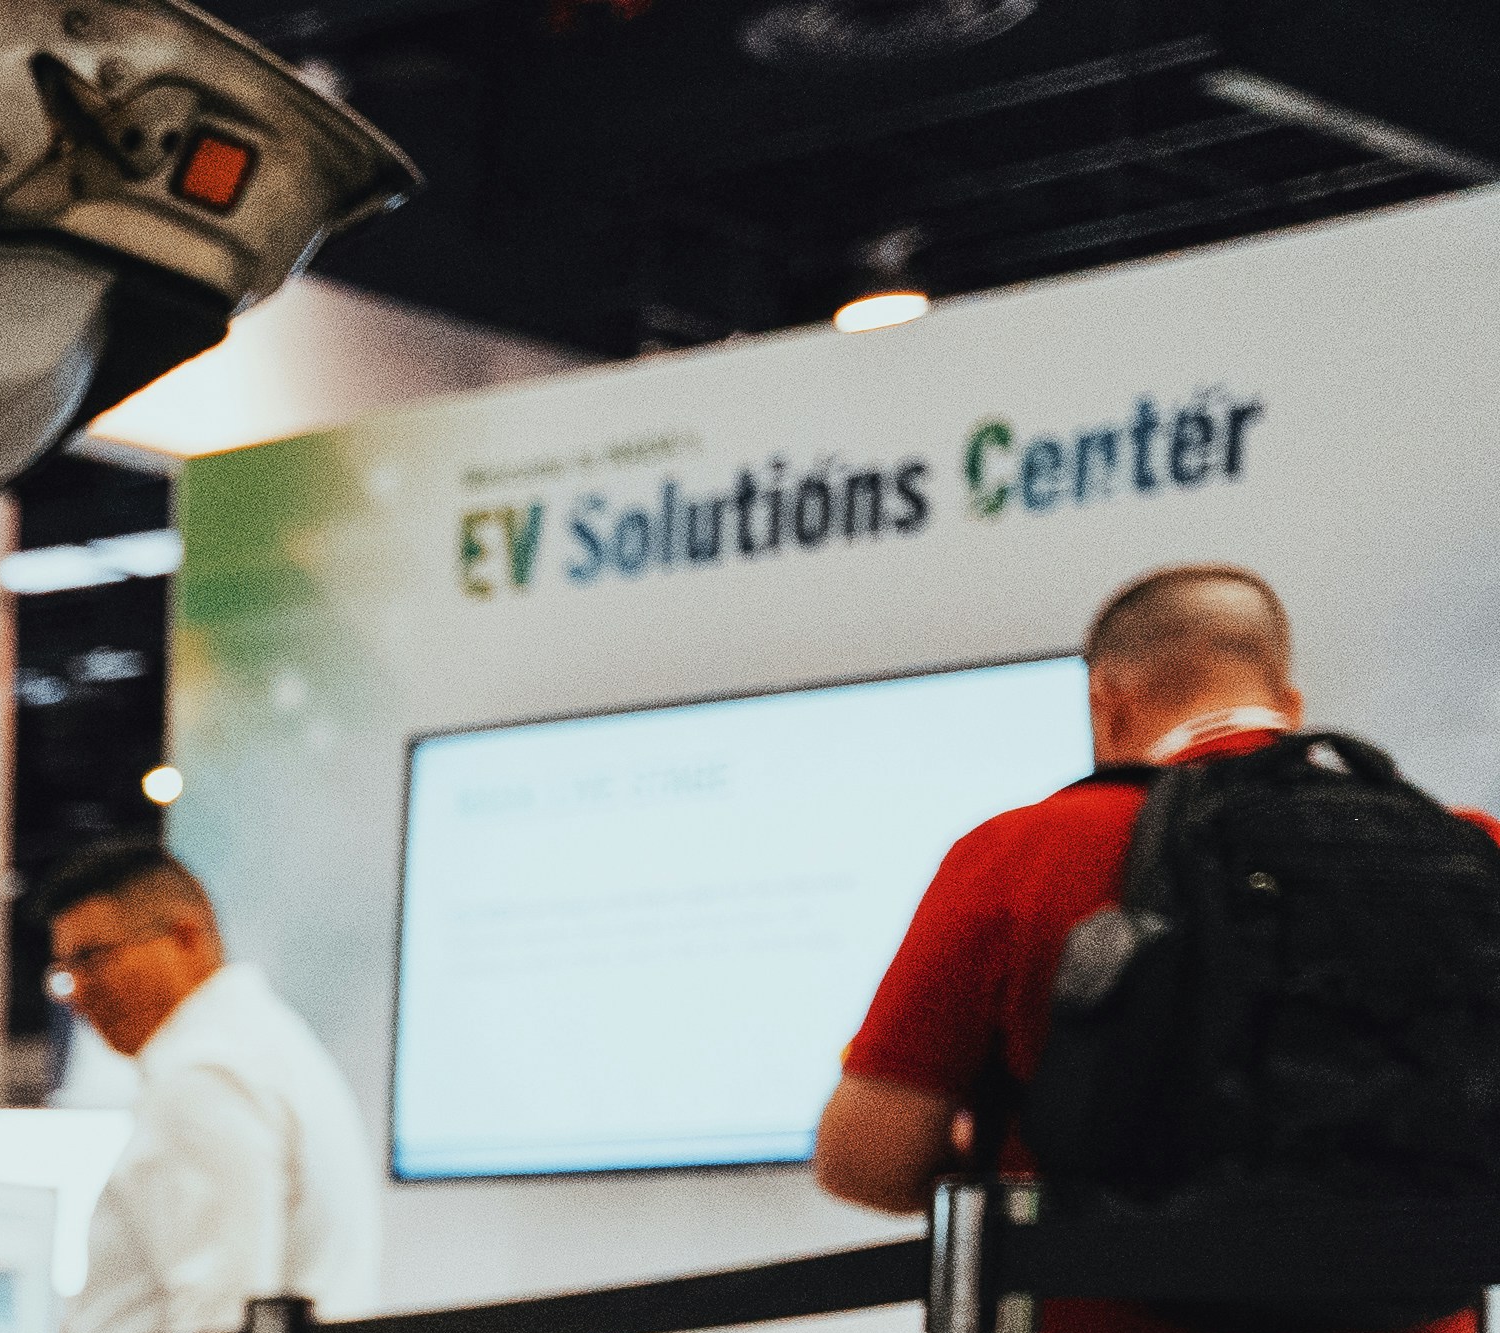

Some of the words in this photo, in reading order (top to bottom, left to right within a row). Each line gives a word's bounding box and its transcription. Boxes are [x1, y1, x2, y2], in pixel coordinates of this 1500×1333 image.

[458, 502, 545, 597] EV
[564, 454, 932, 584] Solutions
[964, 396, 1264, 516] Center
